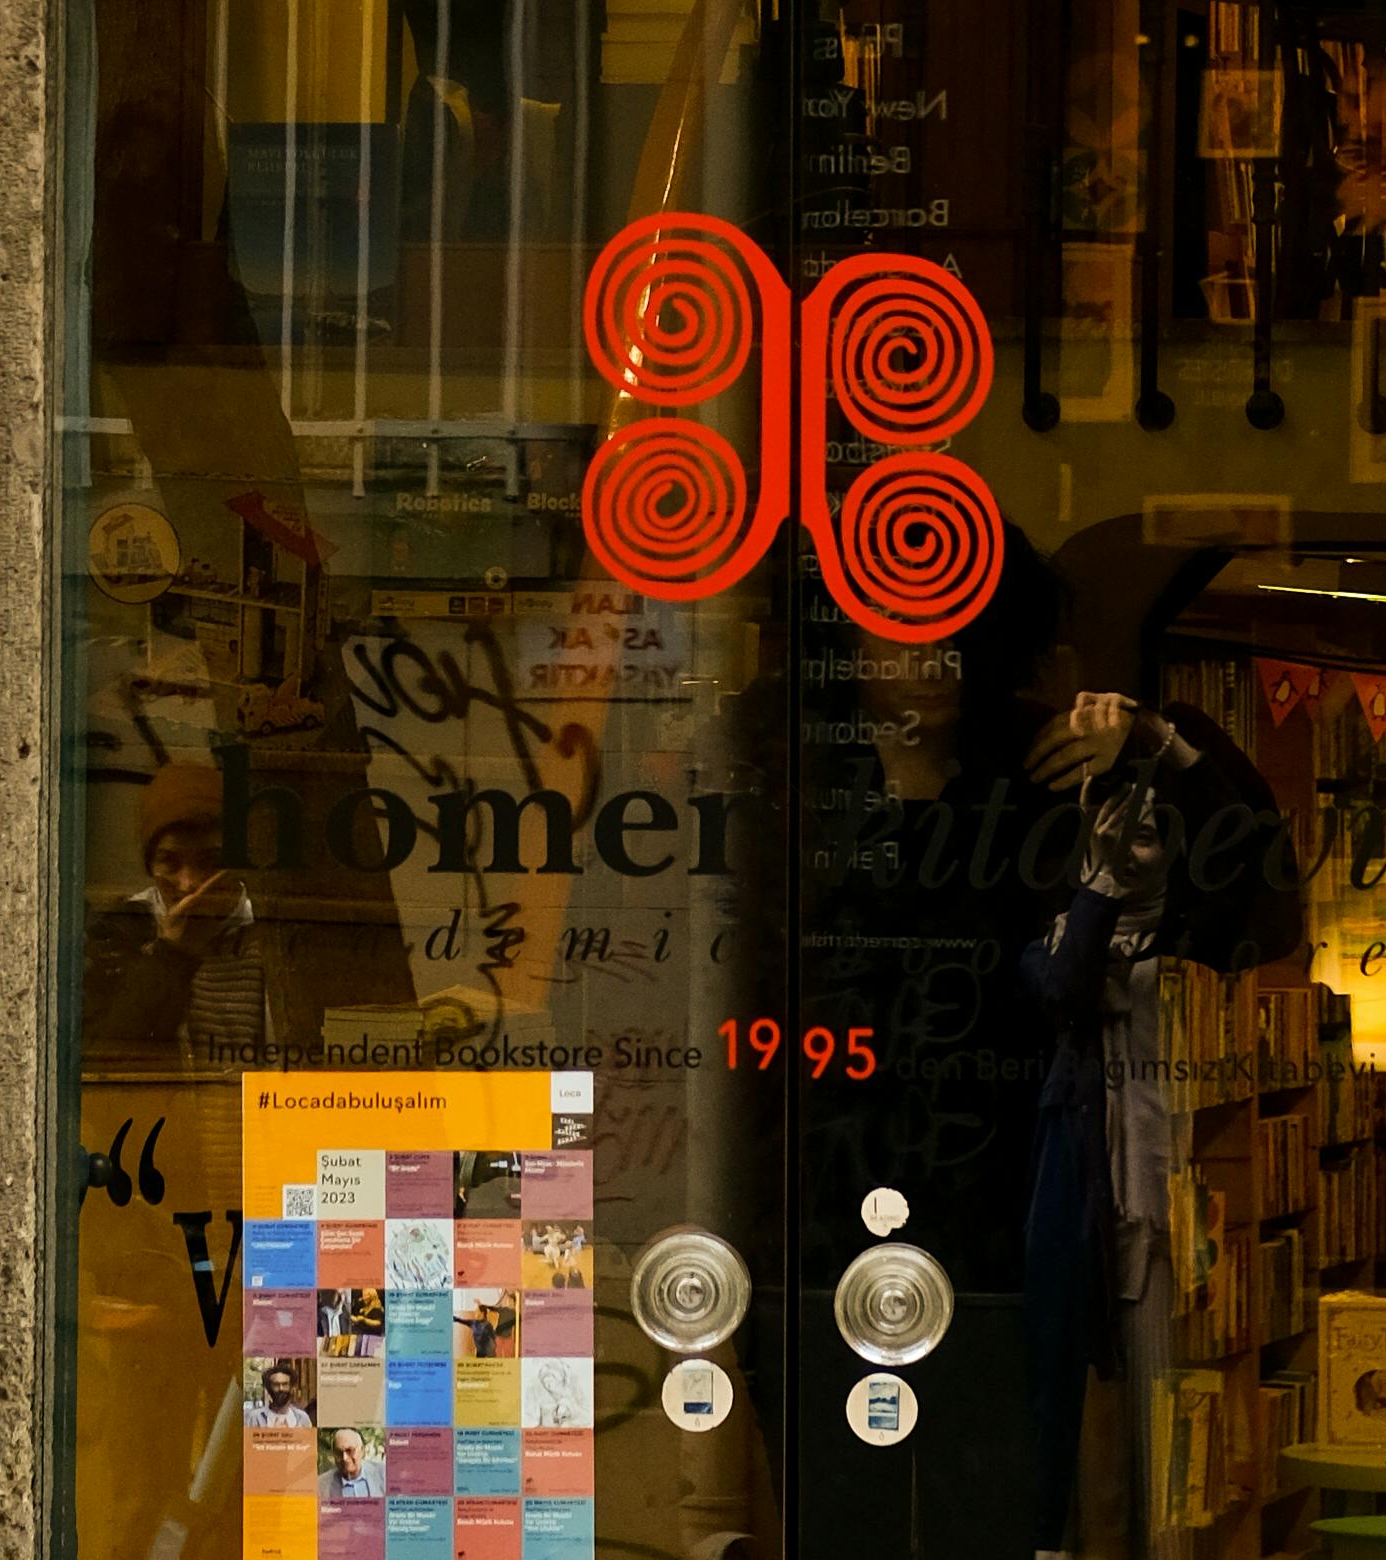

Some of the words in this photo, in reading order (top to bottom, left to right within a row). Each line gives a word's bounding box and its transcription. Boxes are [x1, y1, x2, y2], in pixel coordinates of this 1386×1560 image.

[216, 743, 763, 877] homer
[208, 1034, 423, 1076] Independent
[435, 1035, 603, 1069] Bookstore
[614, 1036, 703, 1069] Since
[258, 1091, 447, 1114] #Locadabuluşalım
[321, 1154, 362, 1169] Şubat
[321, 1174, 361, 1188] Mayıs
[321, 1192, 356, 1205] 2023
[1335, 1326, 1382, 1352] Fairy
